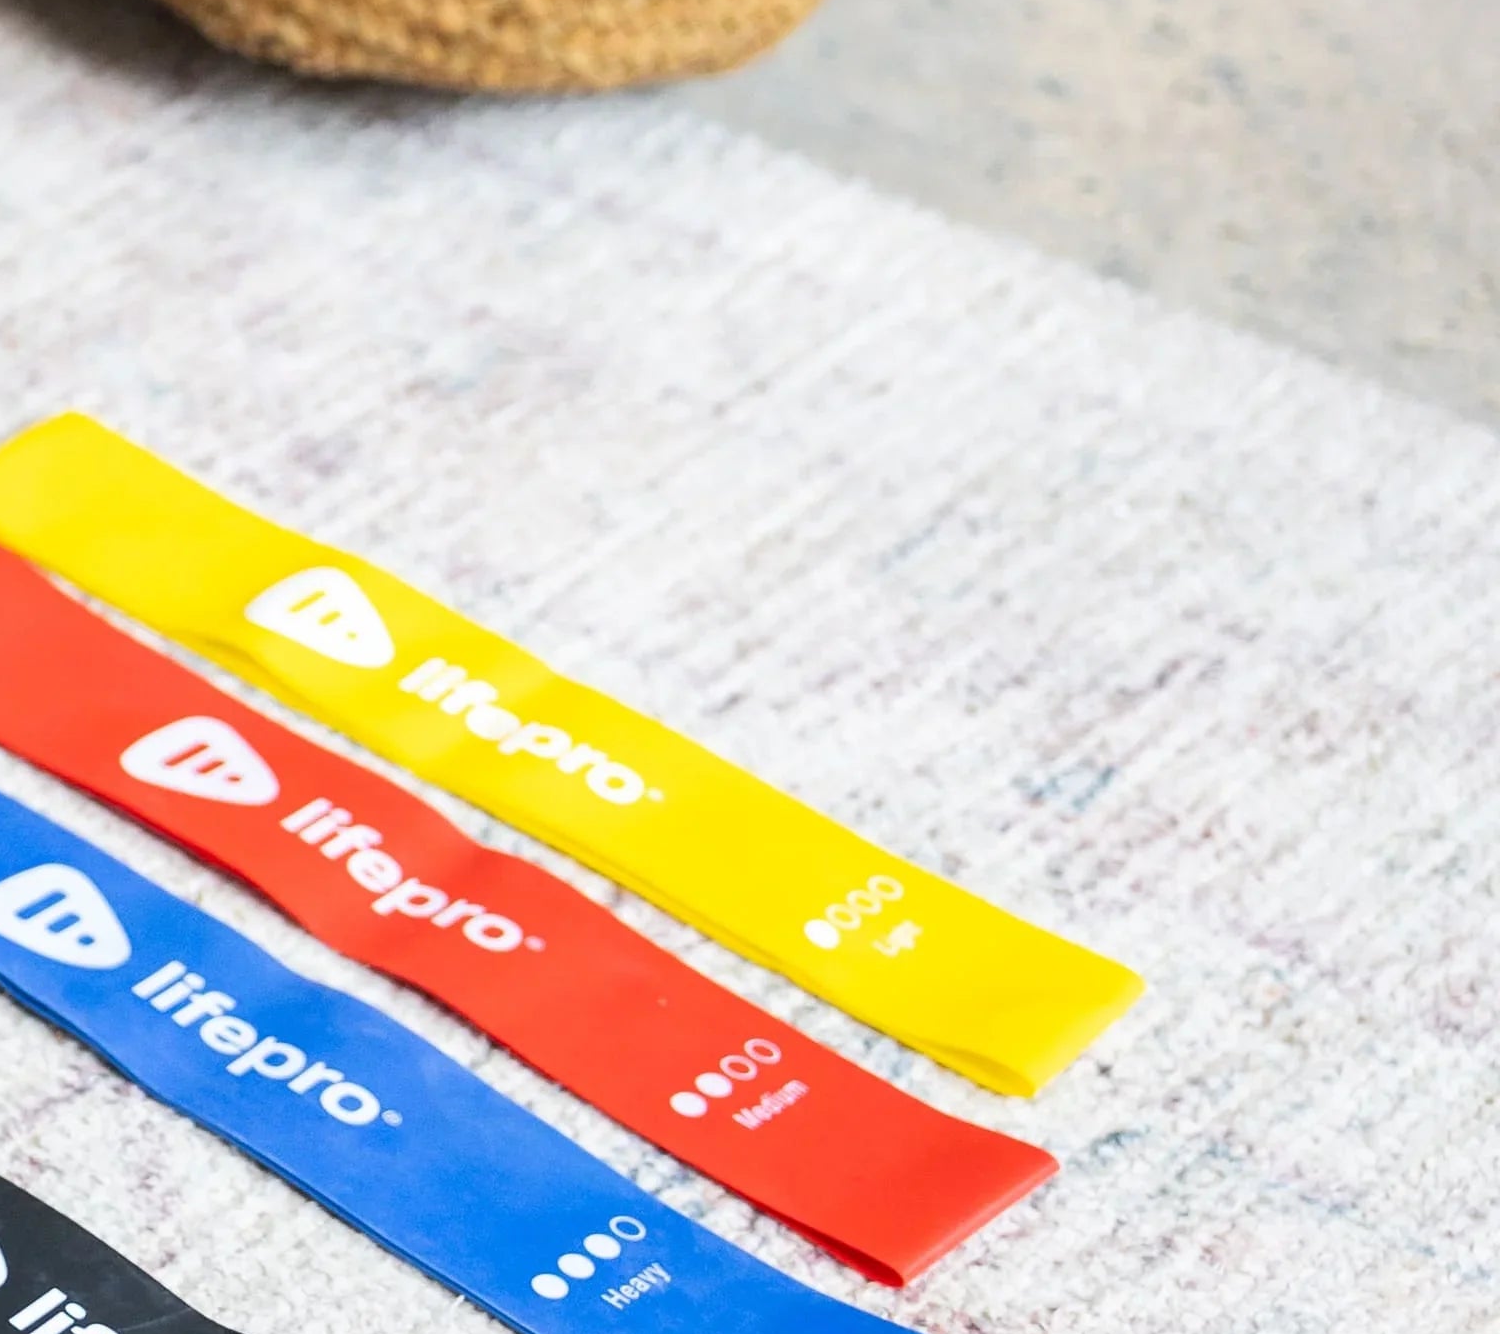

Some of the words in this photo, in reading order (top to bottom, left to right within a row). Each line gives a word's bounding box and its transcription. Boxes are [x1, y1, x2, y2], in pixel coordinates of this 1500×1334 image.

[397, 656, 646, 805] lifepro
[279, 797, 525, 953] lifepro
[131, 960, 382, 1127] lifepro
[601, 1261, 673, 1310] Heavy
